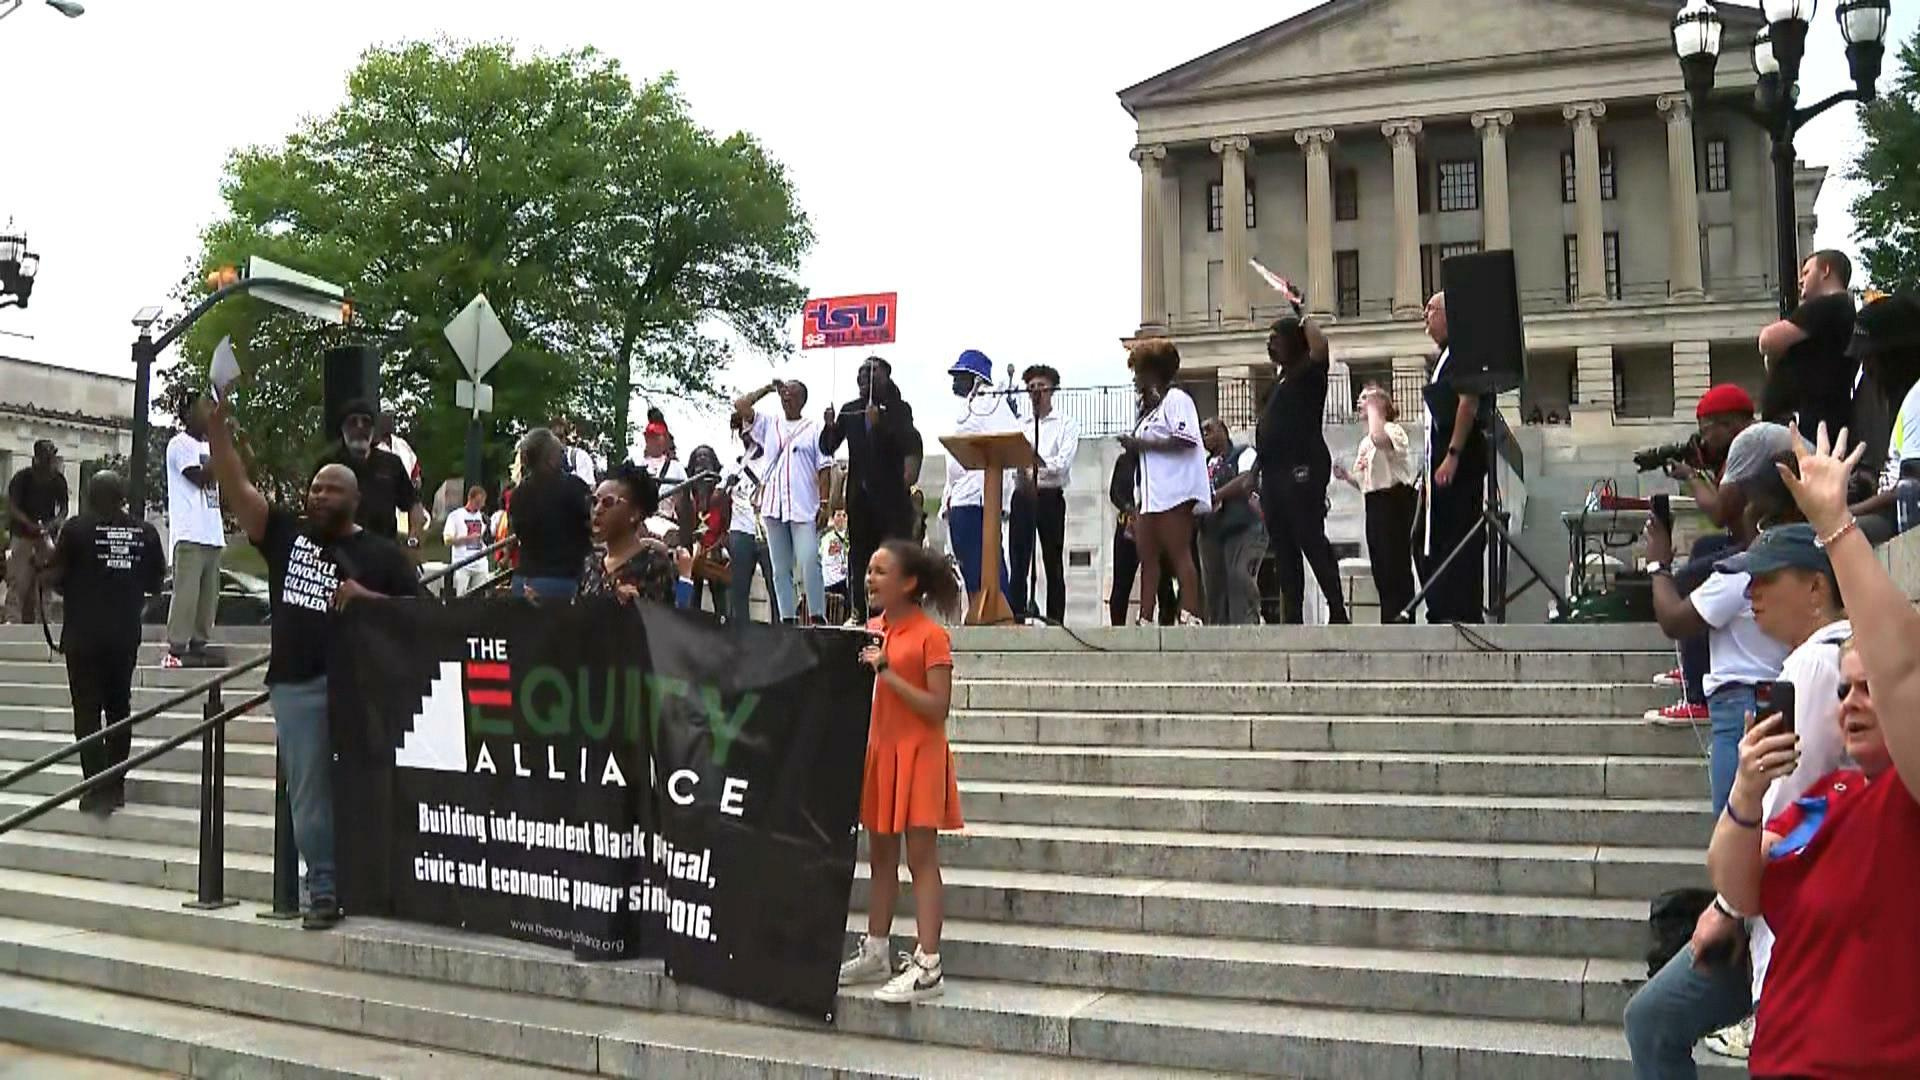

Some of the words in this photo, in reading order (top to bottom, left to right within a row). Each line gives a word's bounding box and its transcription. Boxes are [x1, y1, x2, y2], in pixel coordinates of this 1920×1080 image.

[294, 535, 323, 557] BLAK
[467, 638, 508, 660] THE
[467, 662, 761, 768] EQUITY
[474, 741, 749, 817] ALLIACE
[418, 802, 487, 844] Building
[490, 809, 592, 851] independent
[593, 822, 646, 860] Black
[414, 846, 456, 885] civic
[458, 853, 487, 889] and
[491, 864, 570, 904] economic
[573, 879, 624, 914] power
[628, 873, 671, 914] sin
[666, 899, 718, 942] 016.
